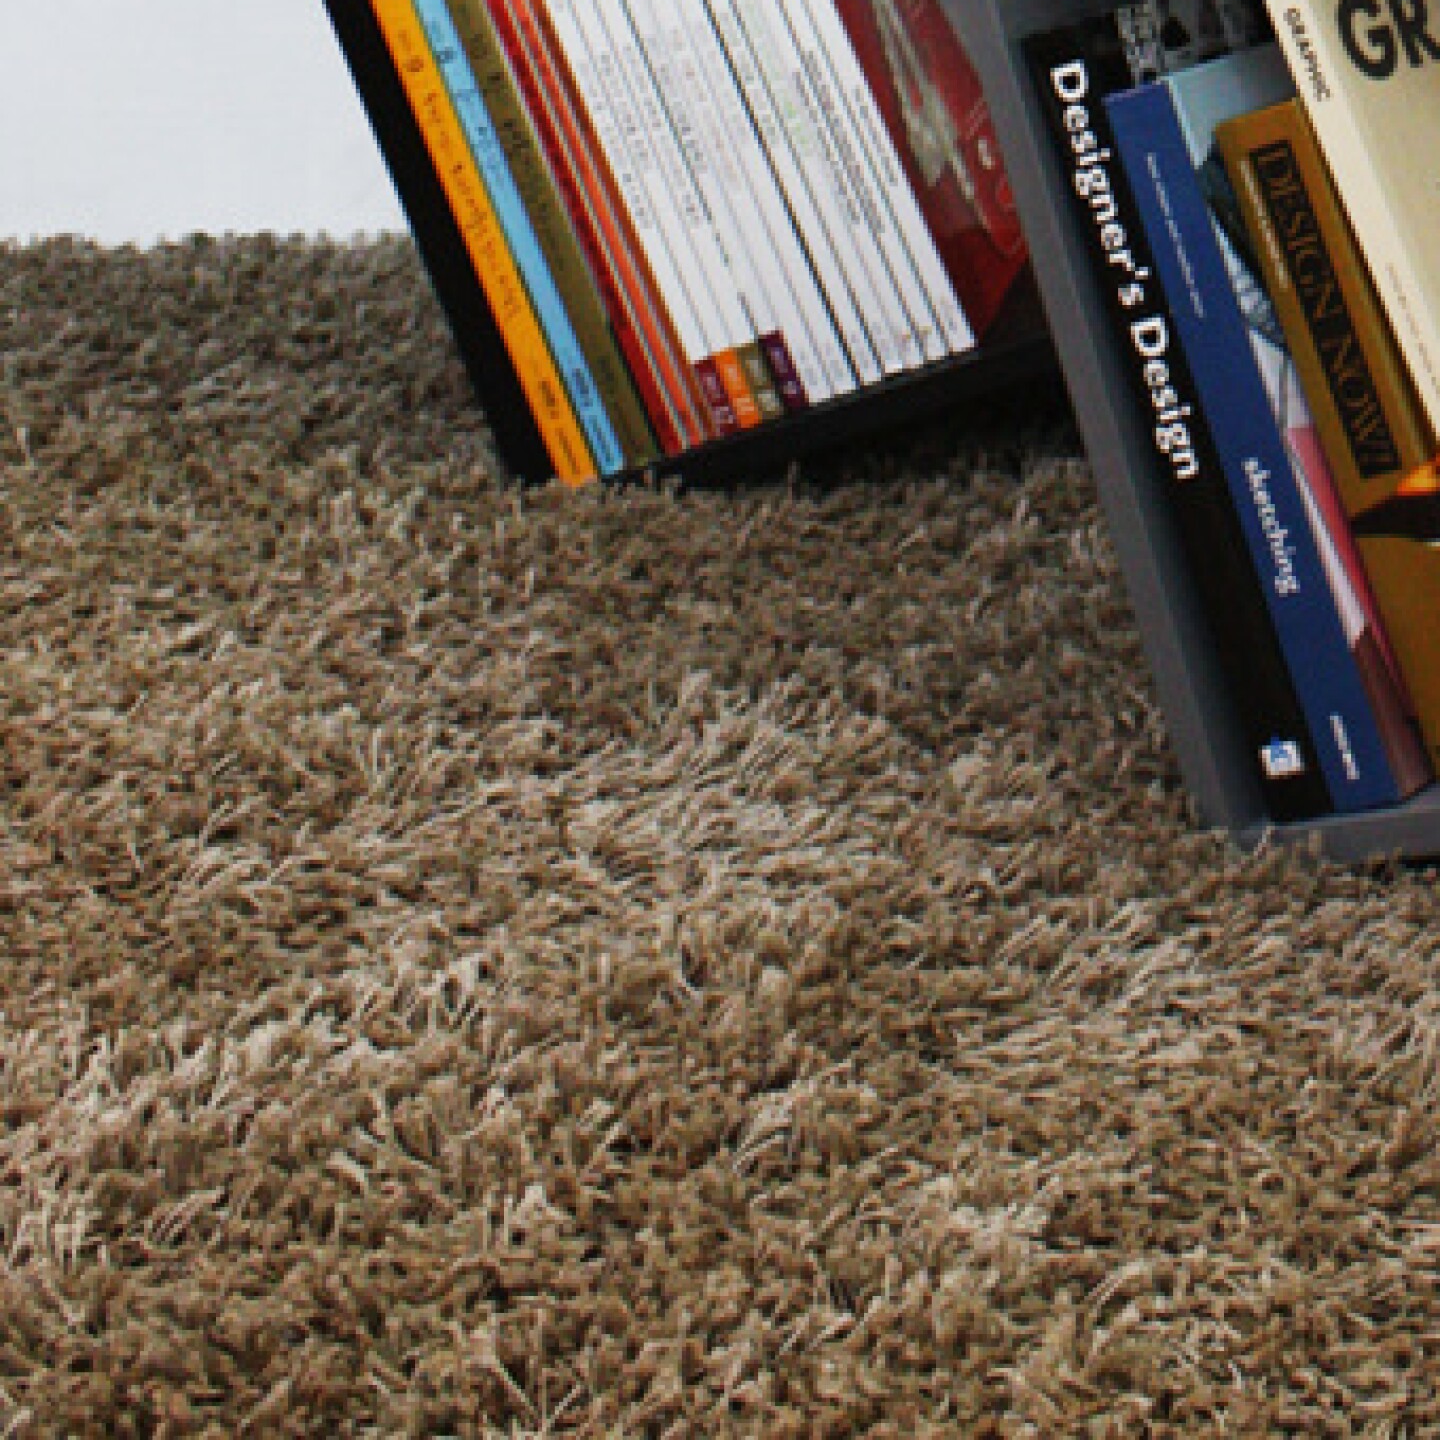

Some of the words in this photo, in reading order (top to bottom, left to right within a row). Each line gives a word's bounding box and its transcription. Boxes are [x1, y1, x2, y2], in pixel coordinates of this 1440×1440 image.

[1285, 9, 1328, 100] GRAPHIC
[1048, 61, 1151, 309] Designer's
[1128, 318, 1201, 481] Design
[1261, 151, 1333, 324] DESIGN
[1243, 457, 1302, 595] sketching
